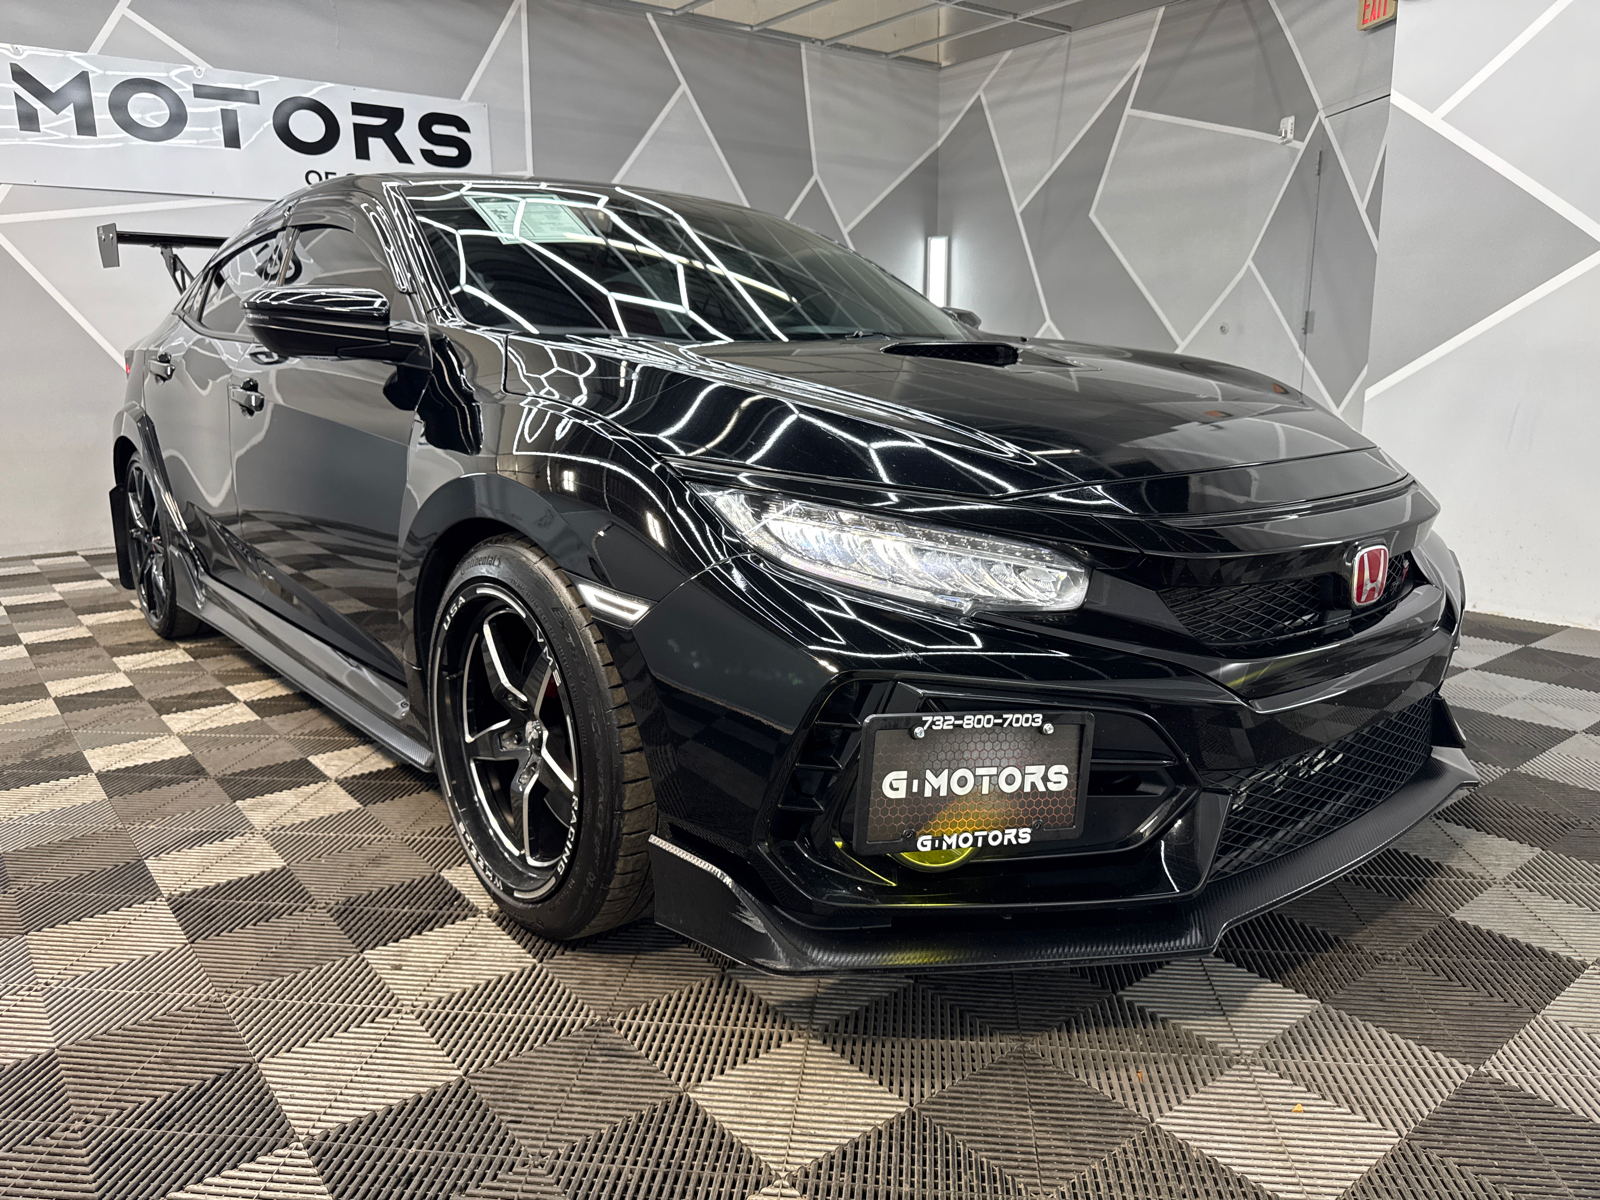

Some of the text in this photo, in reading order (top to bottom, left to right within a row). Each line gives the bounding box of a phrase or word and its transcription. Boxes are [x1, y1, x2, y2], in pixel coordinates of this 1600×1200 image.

[9, 62, 473, 169] MOTORS
[443, 595, 466, 631] USA
[536, 628, 561, 687] VMS
[921, 713, 1043, 730] 732-800-7003
[556, 794, 579, 876] RACING
